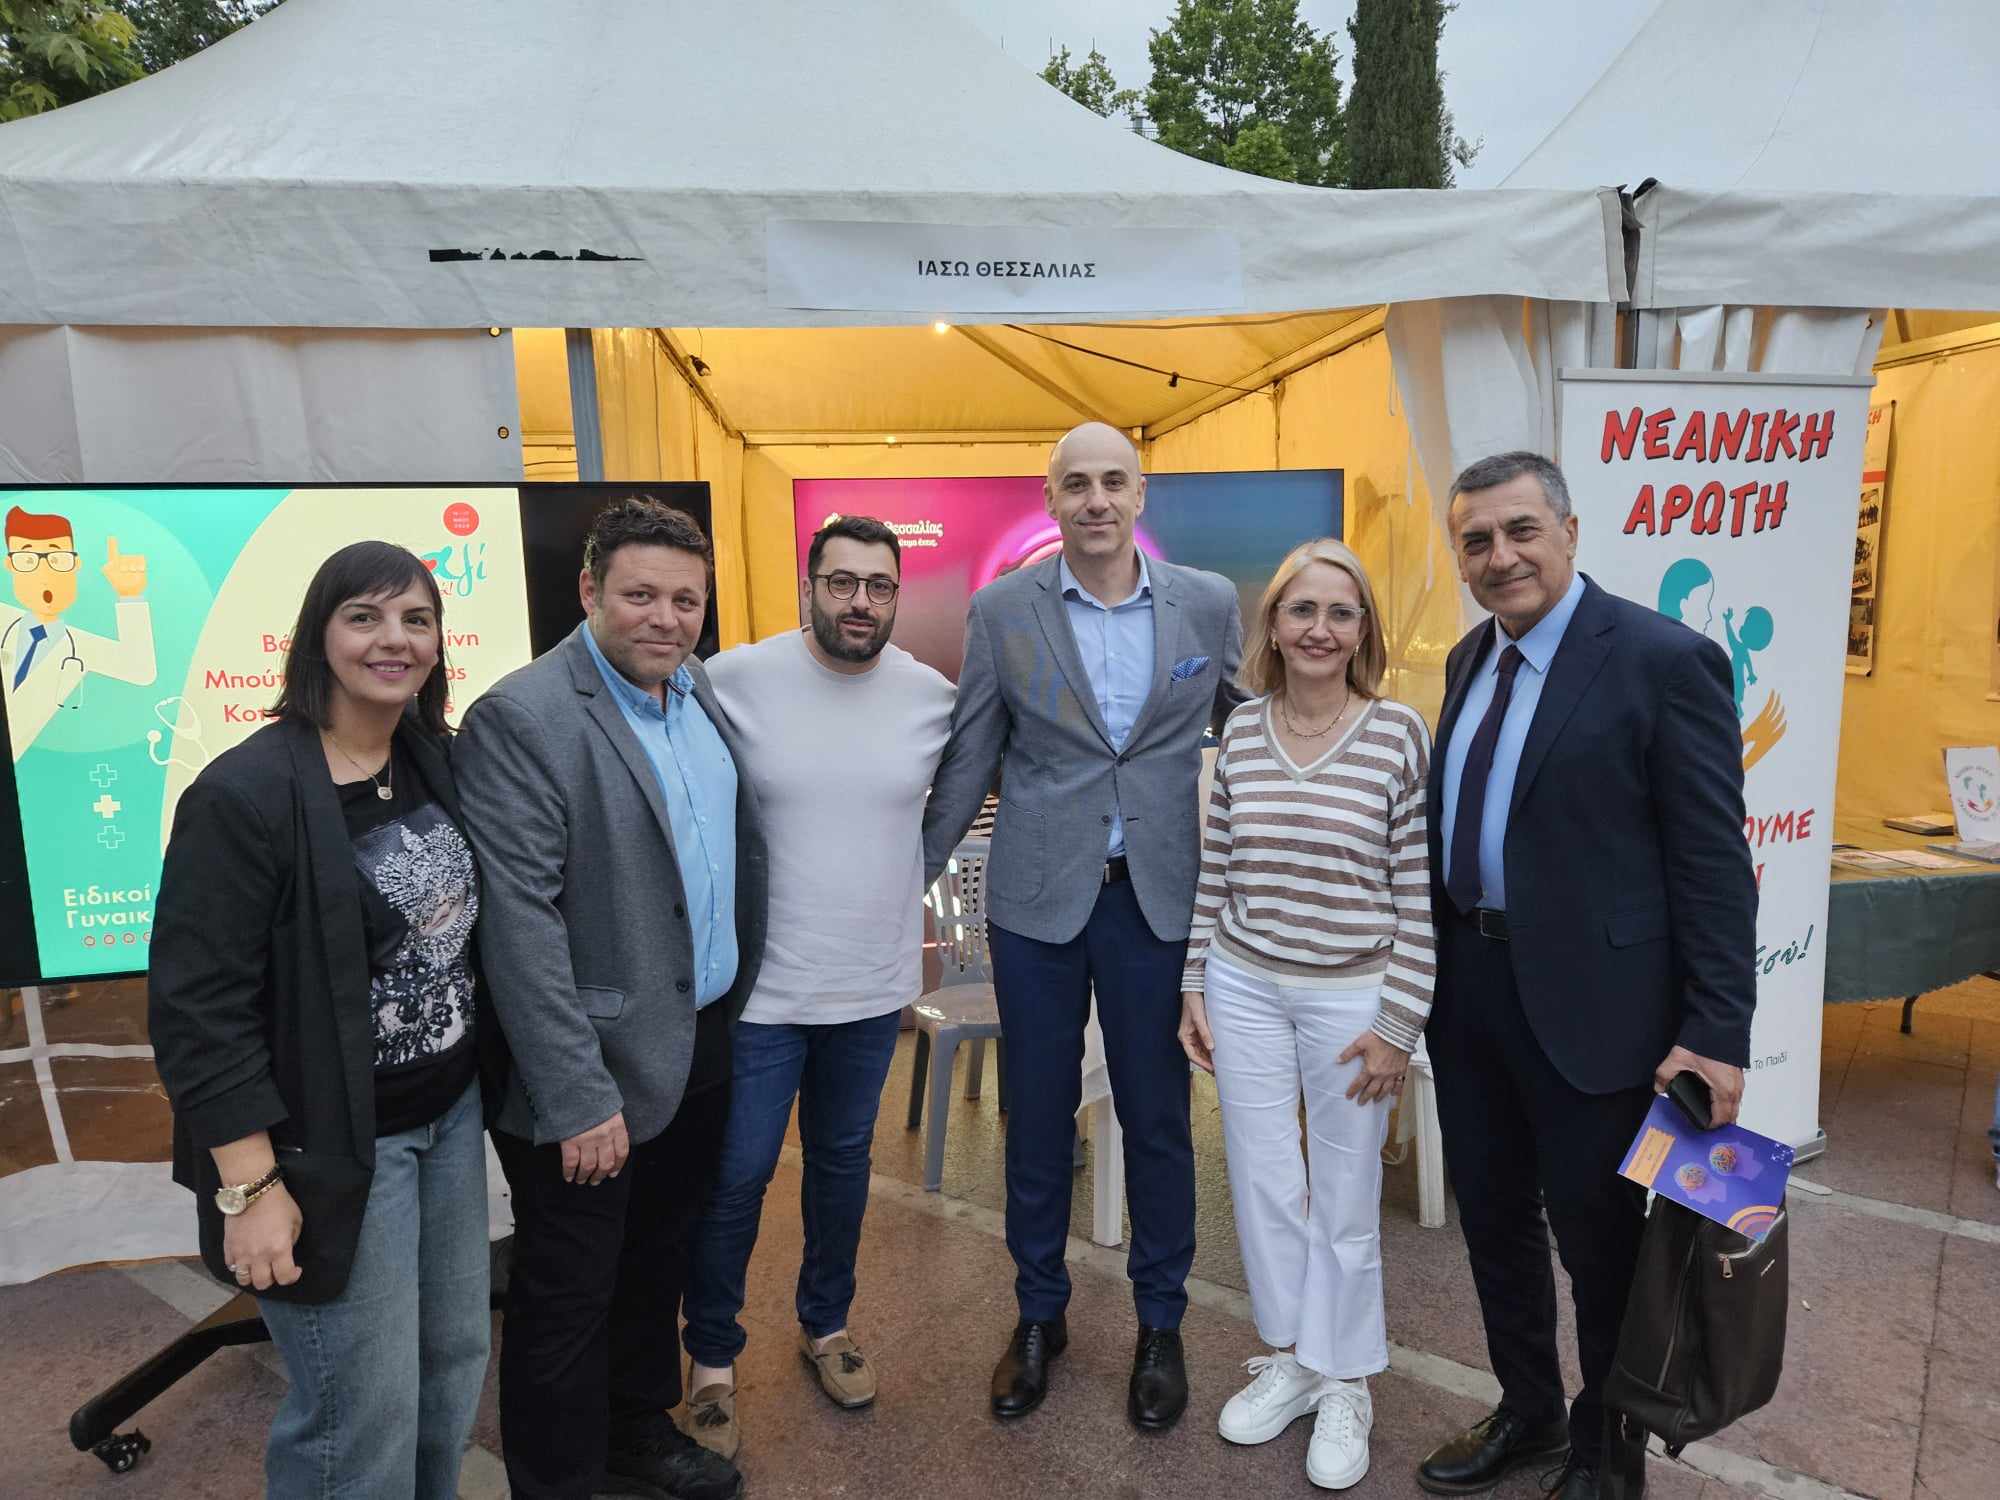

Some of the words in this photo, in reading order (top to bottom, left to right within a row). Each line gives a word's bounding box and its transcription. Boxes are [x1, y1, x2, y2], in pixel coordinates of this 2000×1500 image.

[918, 260, 970, 277] ΙΑΣΩ
[976, 261, 1096, 278] ΘΕΣΣΑΛΙΑΣ
[1600, 406, 1836, 464] ΝΕΑΝΙΚΗ
[204, 668, 287, 689] Μπούτ
[1744, 808, 1815, 849] ΟΥΜΕ
[63, 882, 152, 907] Ειδικοί
[66, 909, 153, 929] Γυναικ
